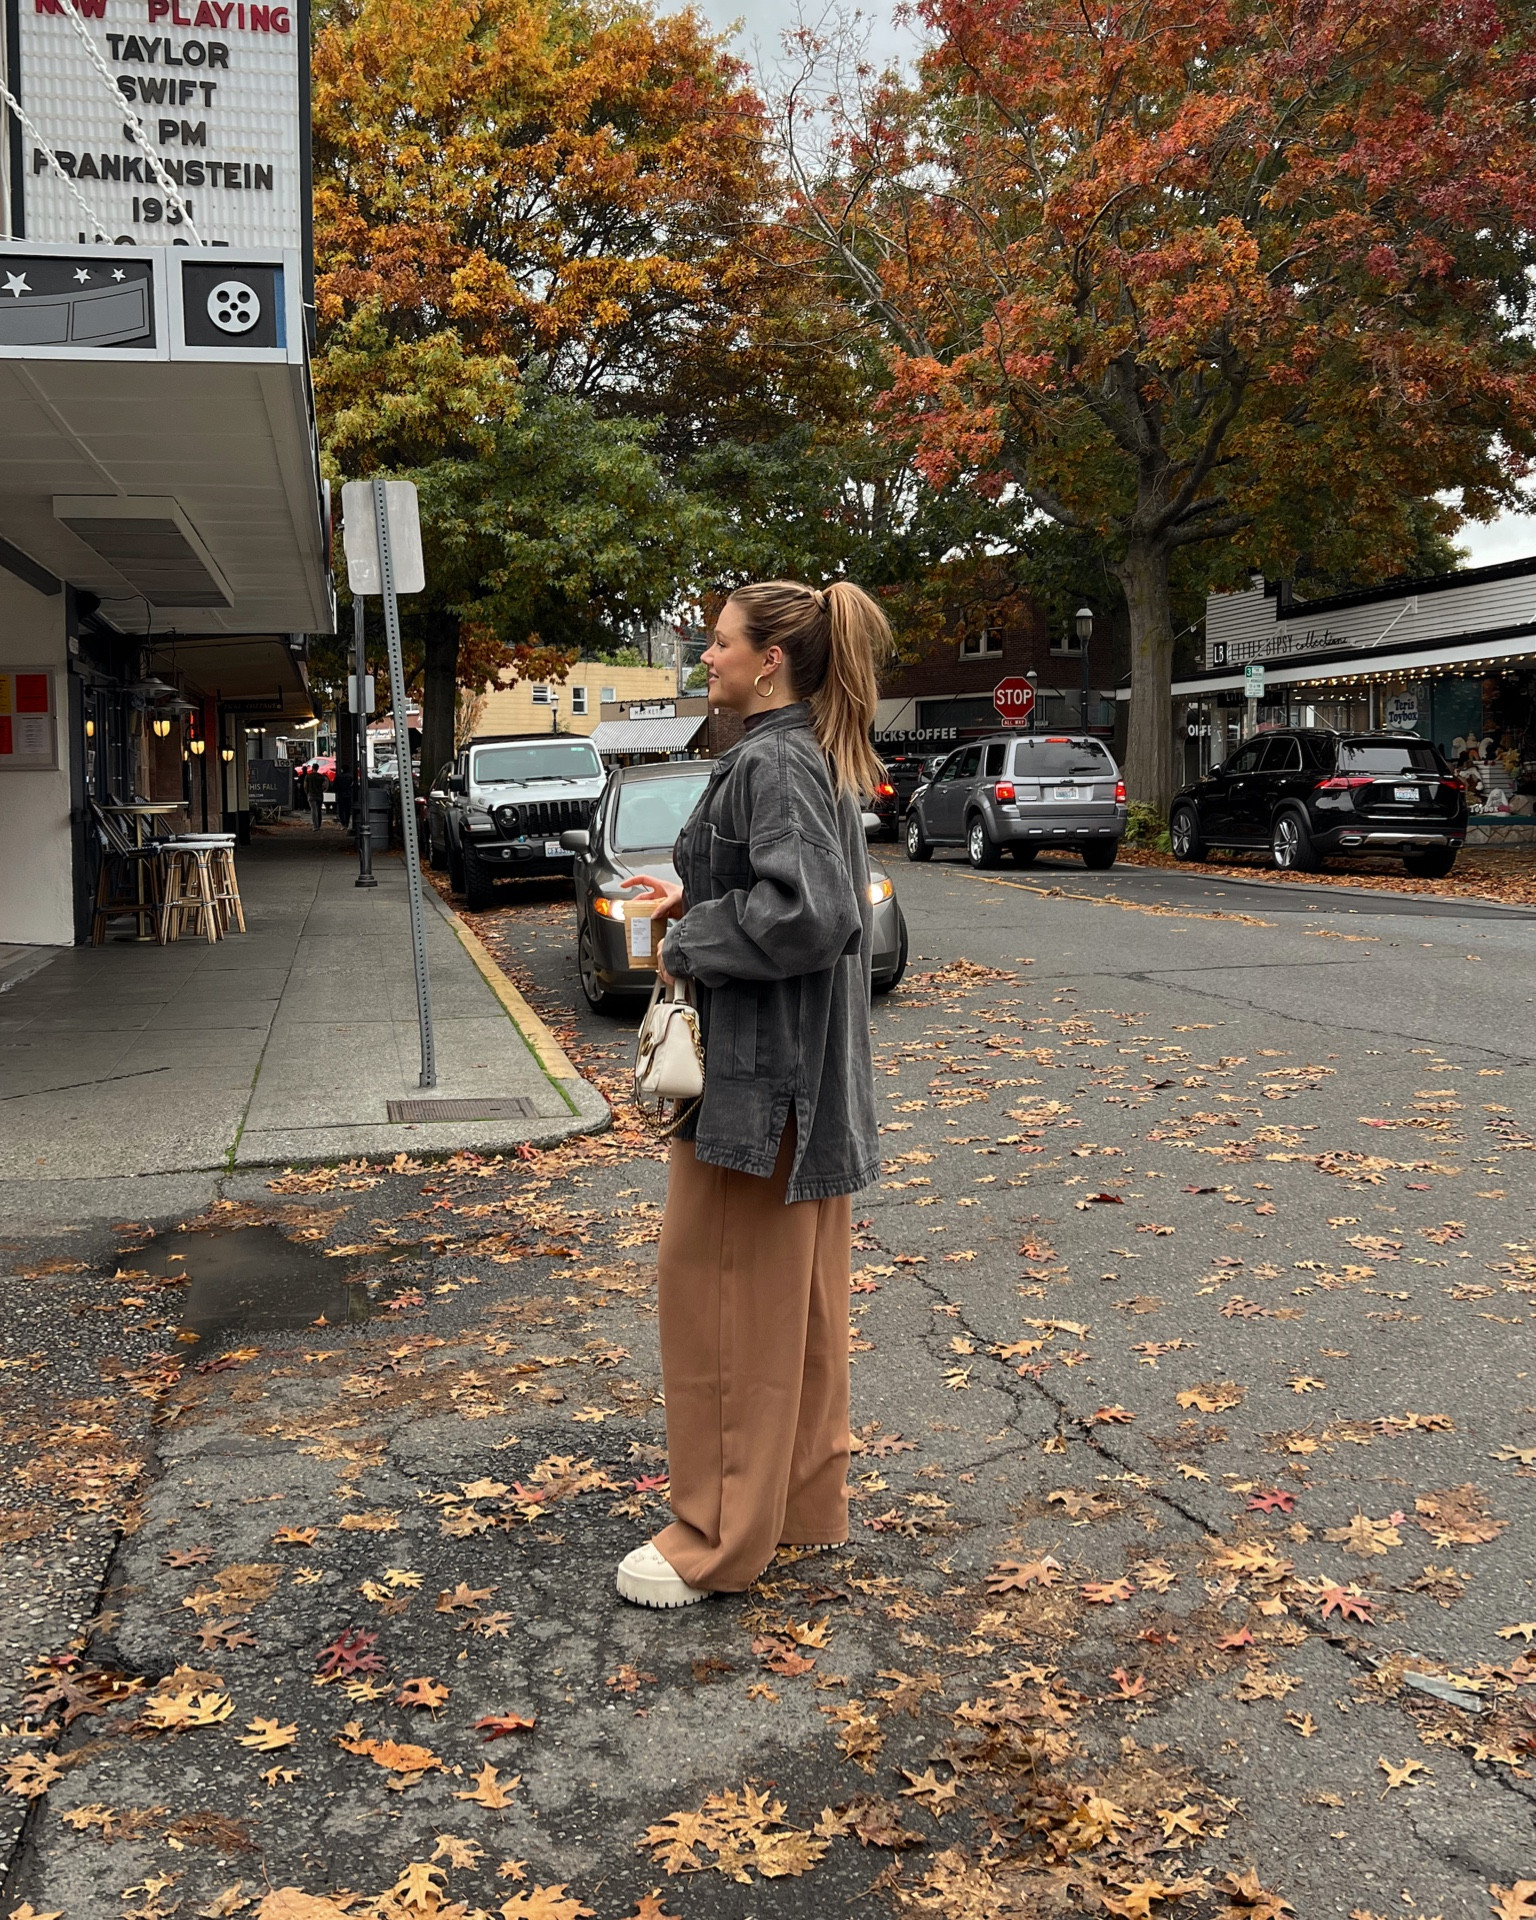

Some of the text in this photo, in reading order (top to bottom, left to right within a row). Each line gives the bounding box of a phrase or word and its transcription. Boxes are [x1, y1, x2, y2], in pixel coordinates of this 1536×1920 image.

[149, 0, 290, 33] PLAYING
[106, 33, 229, 68] TAYLOR
[117, 75, 217, 107] SWIFT
[158, 119, 206, 146] PM
[33, 148, 273, 190] FRANKENSTEIN
[132, 196, 194, 225] 1931
[1246, 667, 1252, 676] 3
[996, 689, 1032, 704] STOP
[1388, 711, 1418, 724] Toybox
[908, 727, 958, 741] COFFEE
[1470, 805, 1499, 814] Toybox
